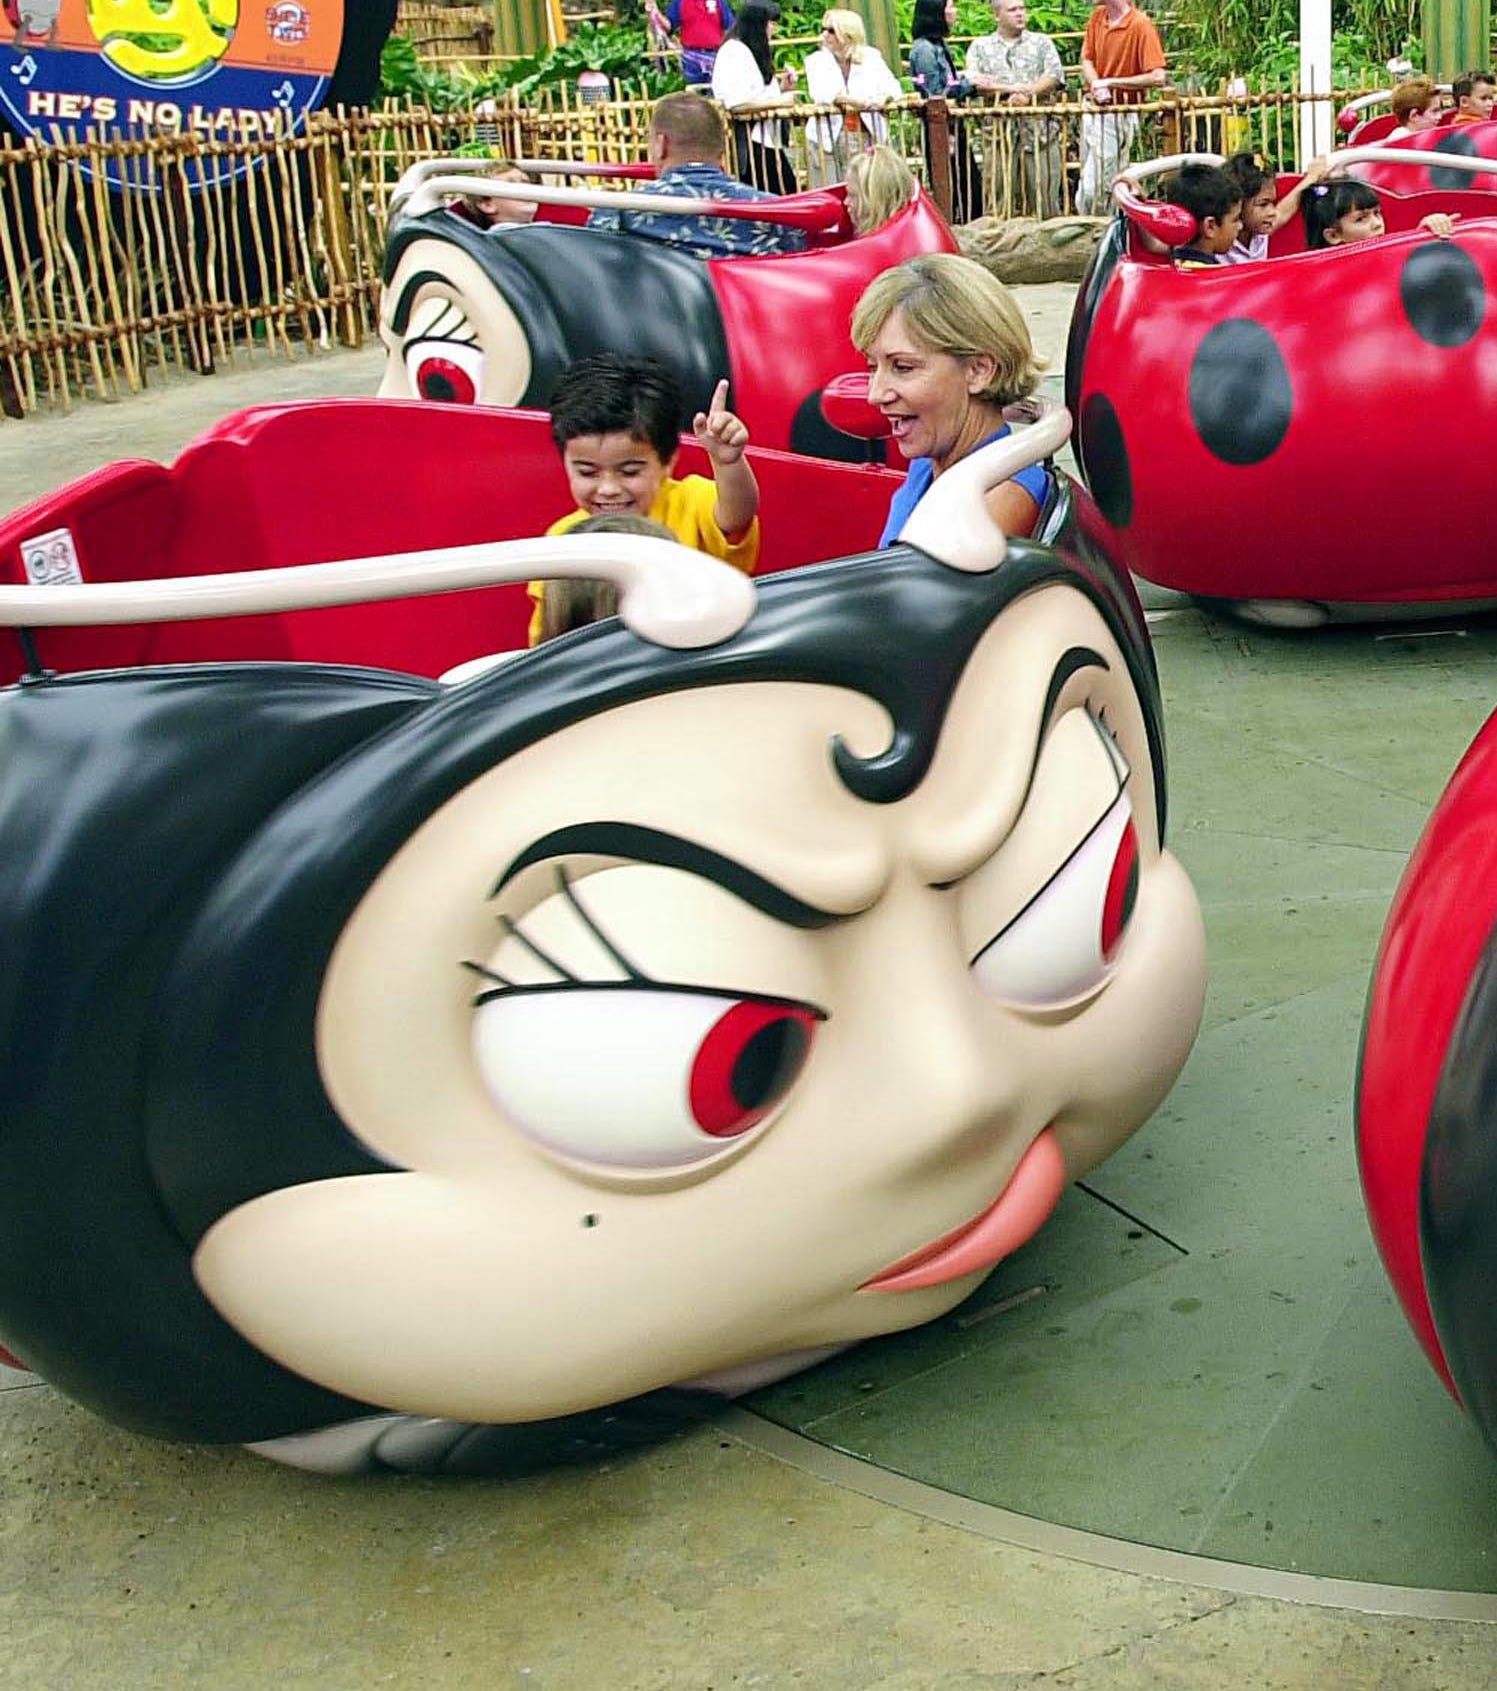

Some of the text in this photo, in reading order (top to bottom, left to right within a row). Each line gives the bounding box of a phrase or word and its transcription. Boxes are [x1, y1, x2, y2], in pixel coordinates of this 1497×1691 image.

[28, 90, 278, 134] HE'S NO LADY
